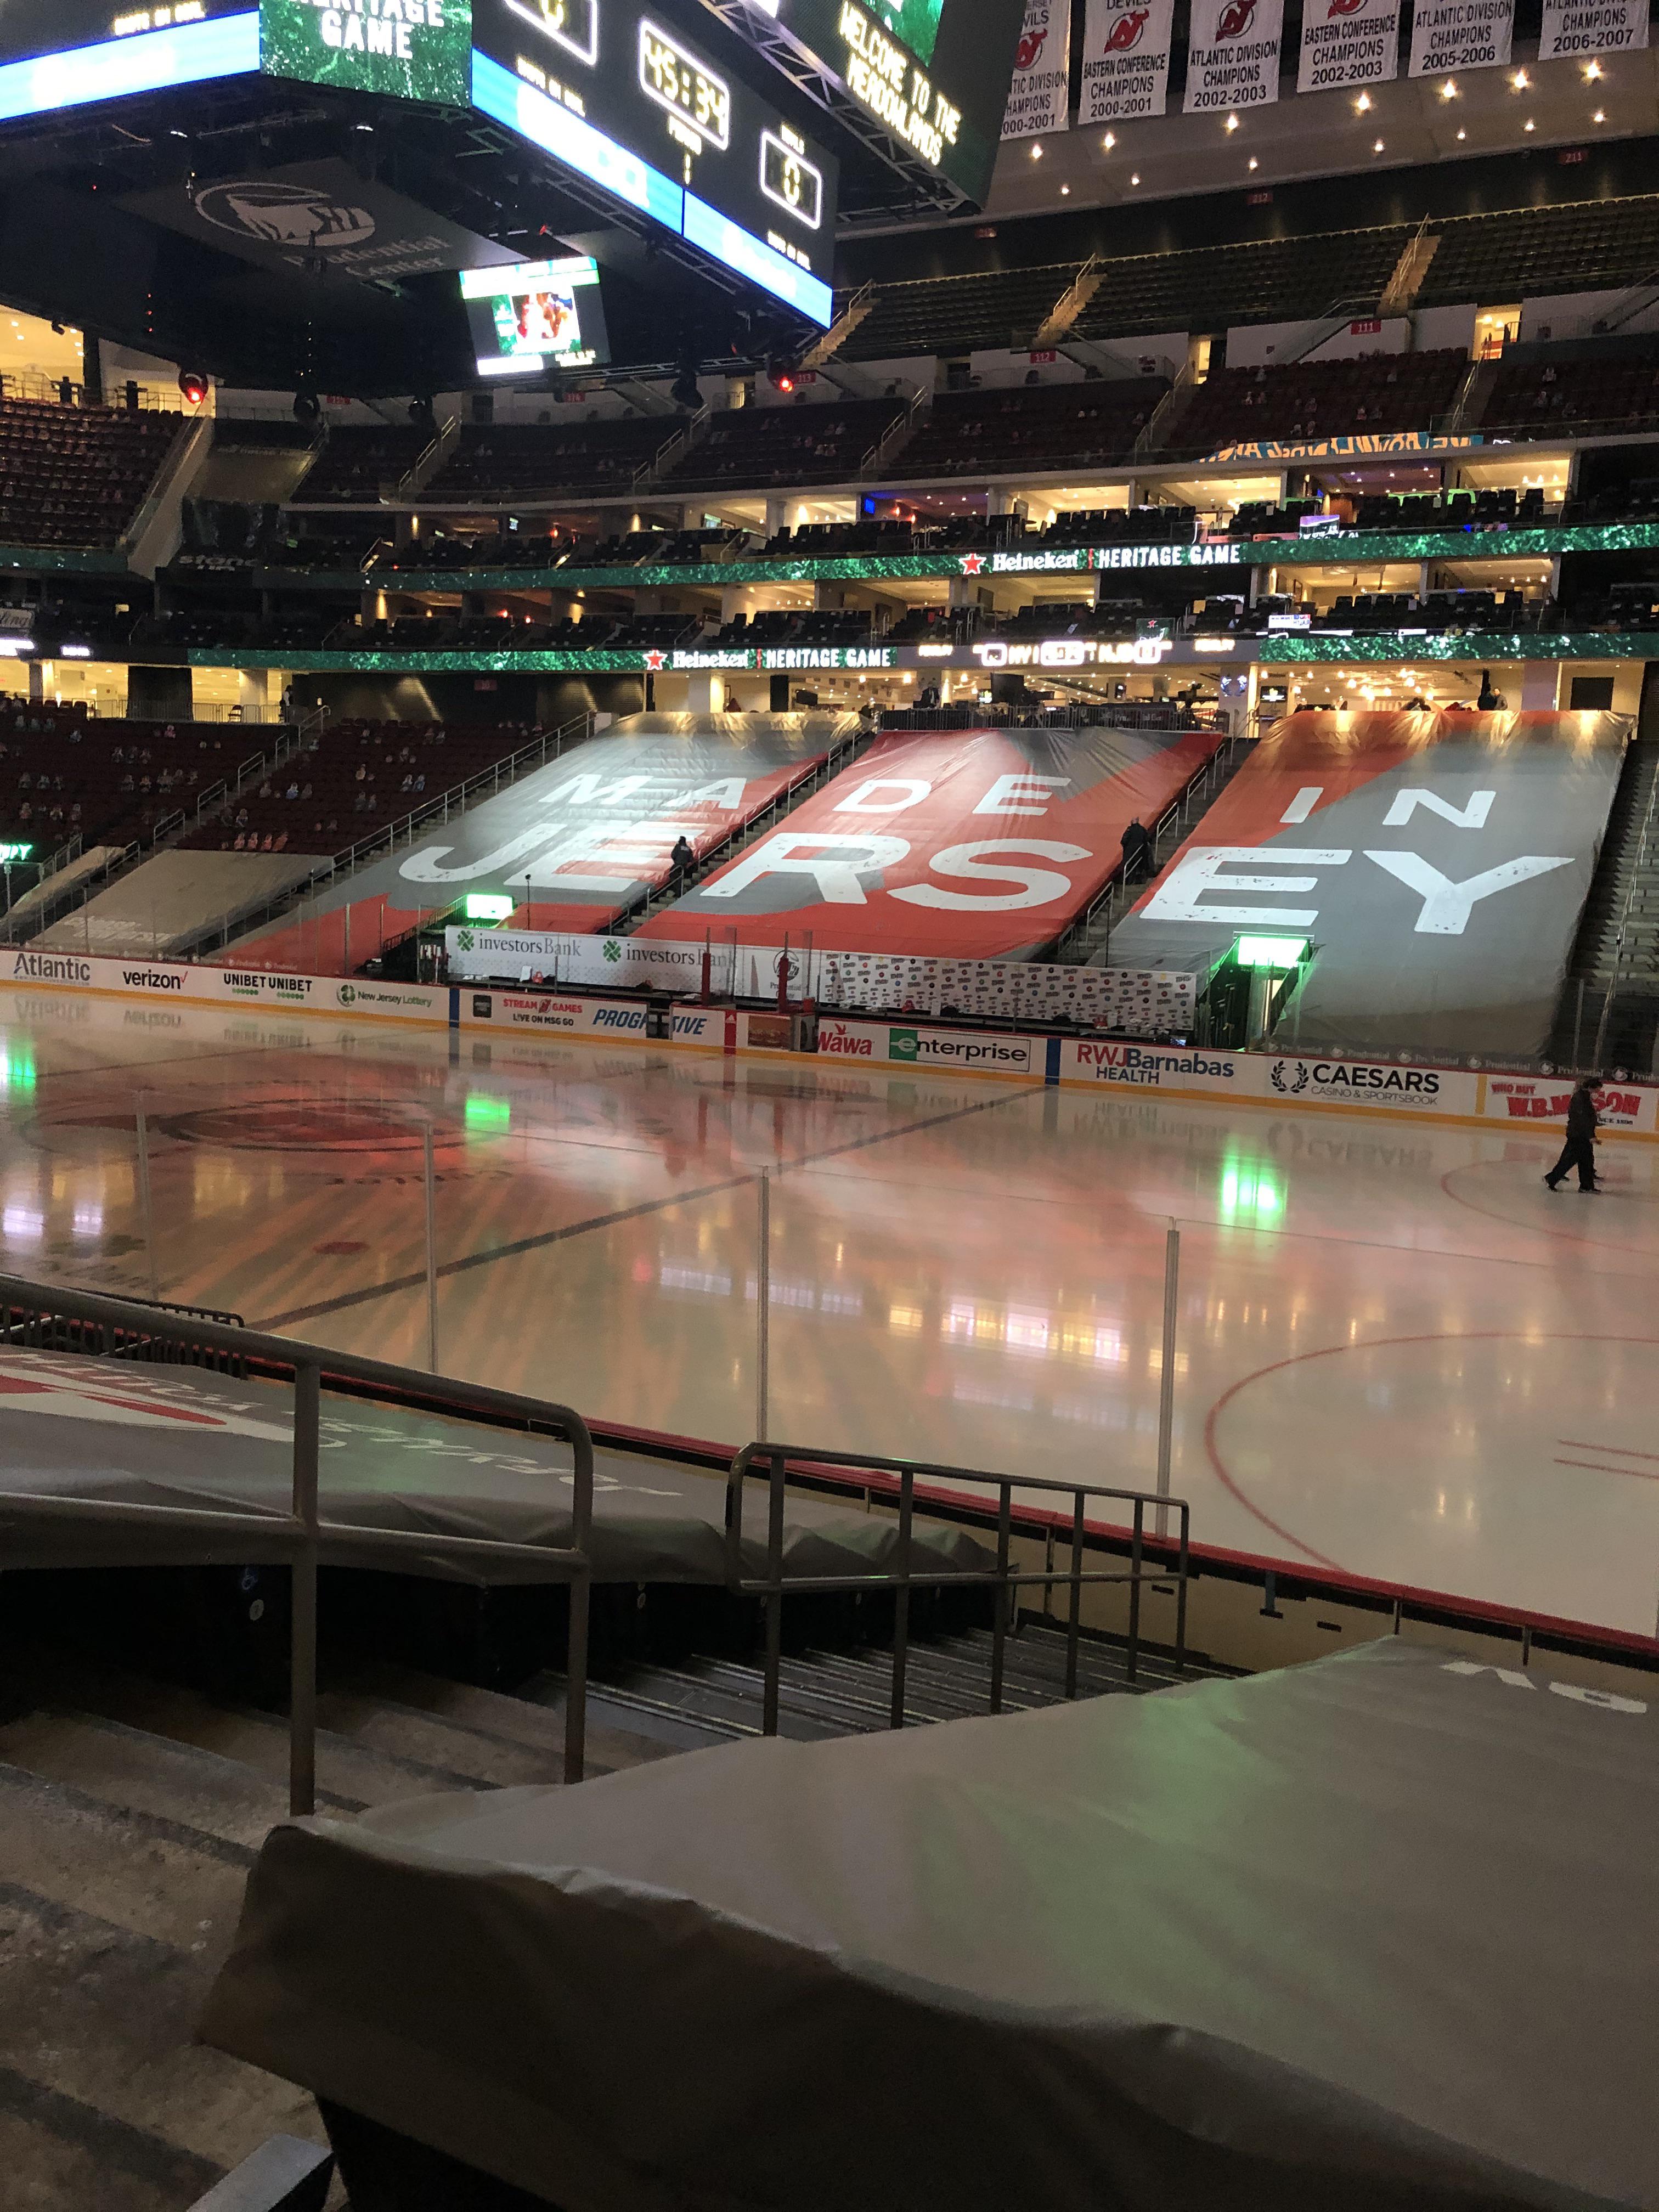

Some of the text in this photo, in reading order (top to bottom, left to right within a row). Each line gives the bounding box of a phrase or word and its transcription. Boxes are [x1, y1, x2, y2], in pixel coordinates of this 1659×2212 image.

[1024, 10, 1049, 27] VILS
[1415, 1, 1511, 28] ATLANTIC DIVISION
[1563, 8, 1626, 31] CHAMPIONS
[321, 10, 413, 59] GAME
[1305, 15, 1395, 44] EASTERN CONFERENCE
[1431, 25, 1491, 49] CHAMPIONS
[1553, 29, 1633, 52] 2006-2007
[1190, 40, 1277, 66] ATLANTIC DIVISION
[1312, 40, 1384, 65] CHAMPIONS
[1423, 46, 1495, 70] 2005-2006
[840, 1, 961, 145] WELCOME TO THE
[1083, 53, 1165, 79] EASTERN CONFERENCE
[1203, 65, 1260, 87] CHAMPIONS
[1312, 61, 1383, 86] 2002-2003
[1029, 70, 1067, 93] DIVISION
[1091, 76, 1154, 100] CHAMPIONS
[1006, 93, 1051, 117] HAMPIONS
[1091, 97, 1152, 117] 2000-2001
[1193, 84, 1266, 108] 2002-2003
[847, 53, 943, 166] MEADOWLANDS
[1003, 114, 1054, 134] 000-2001
[1357, 323, 1374, 332] 111
[1035, 352, 1049, 362] 112
[992, 544, 1240, 572] Heineken HERITAGE GAME
[673, 648, 891, 668] Heineken HERITAGE GAME
[1280, 787, 1496, 828] IN
[14, 952, 91, 981] Atlantic
[123, 969, 181, 989] verizon
[224, 973, 312, 992] UNIBET UNIBET
[358, 991, 432, 1008] New Jersey Lottery
[503, 998, 583, 1013] STREAM GAMES
[532, 1015, 543, 1024] ON
[544, 1016, 561, 1025] MSG
[562, 1018, 574, 1026] GO
[898, 1036, 1027, 1061] enterprise
[1096, 1066, 1160, 1085] HEALTH
[1312, 1063, 1440, 1094] CAESARS
[1311, 1086, 1438, 1105] CASINO & SPORTSBOOK
[1491, 1083, 1536, 1094] WHO BUT
